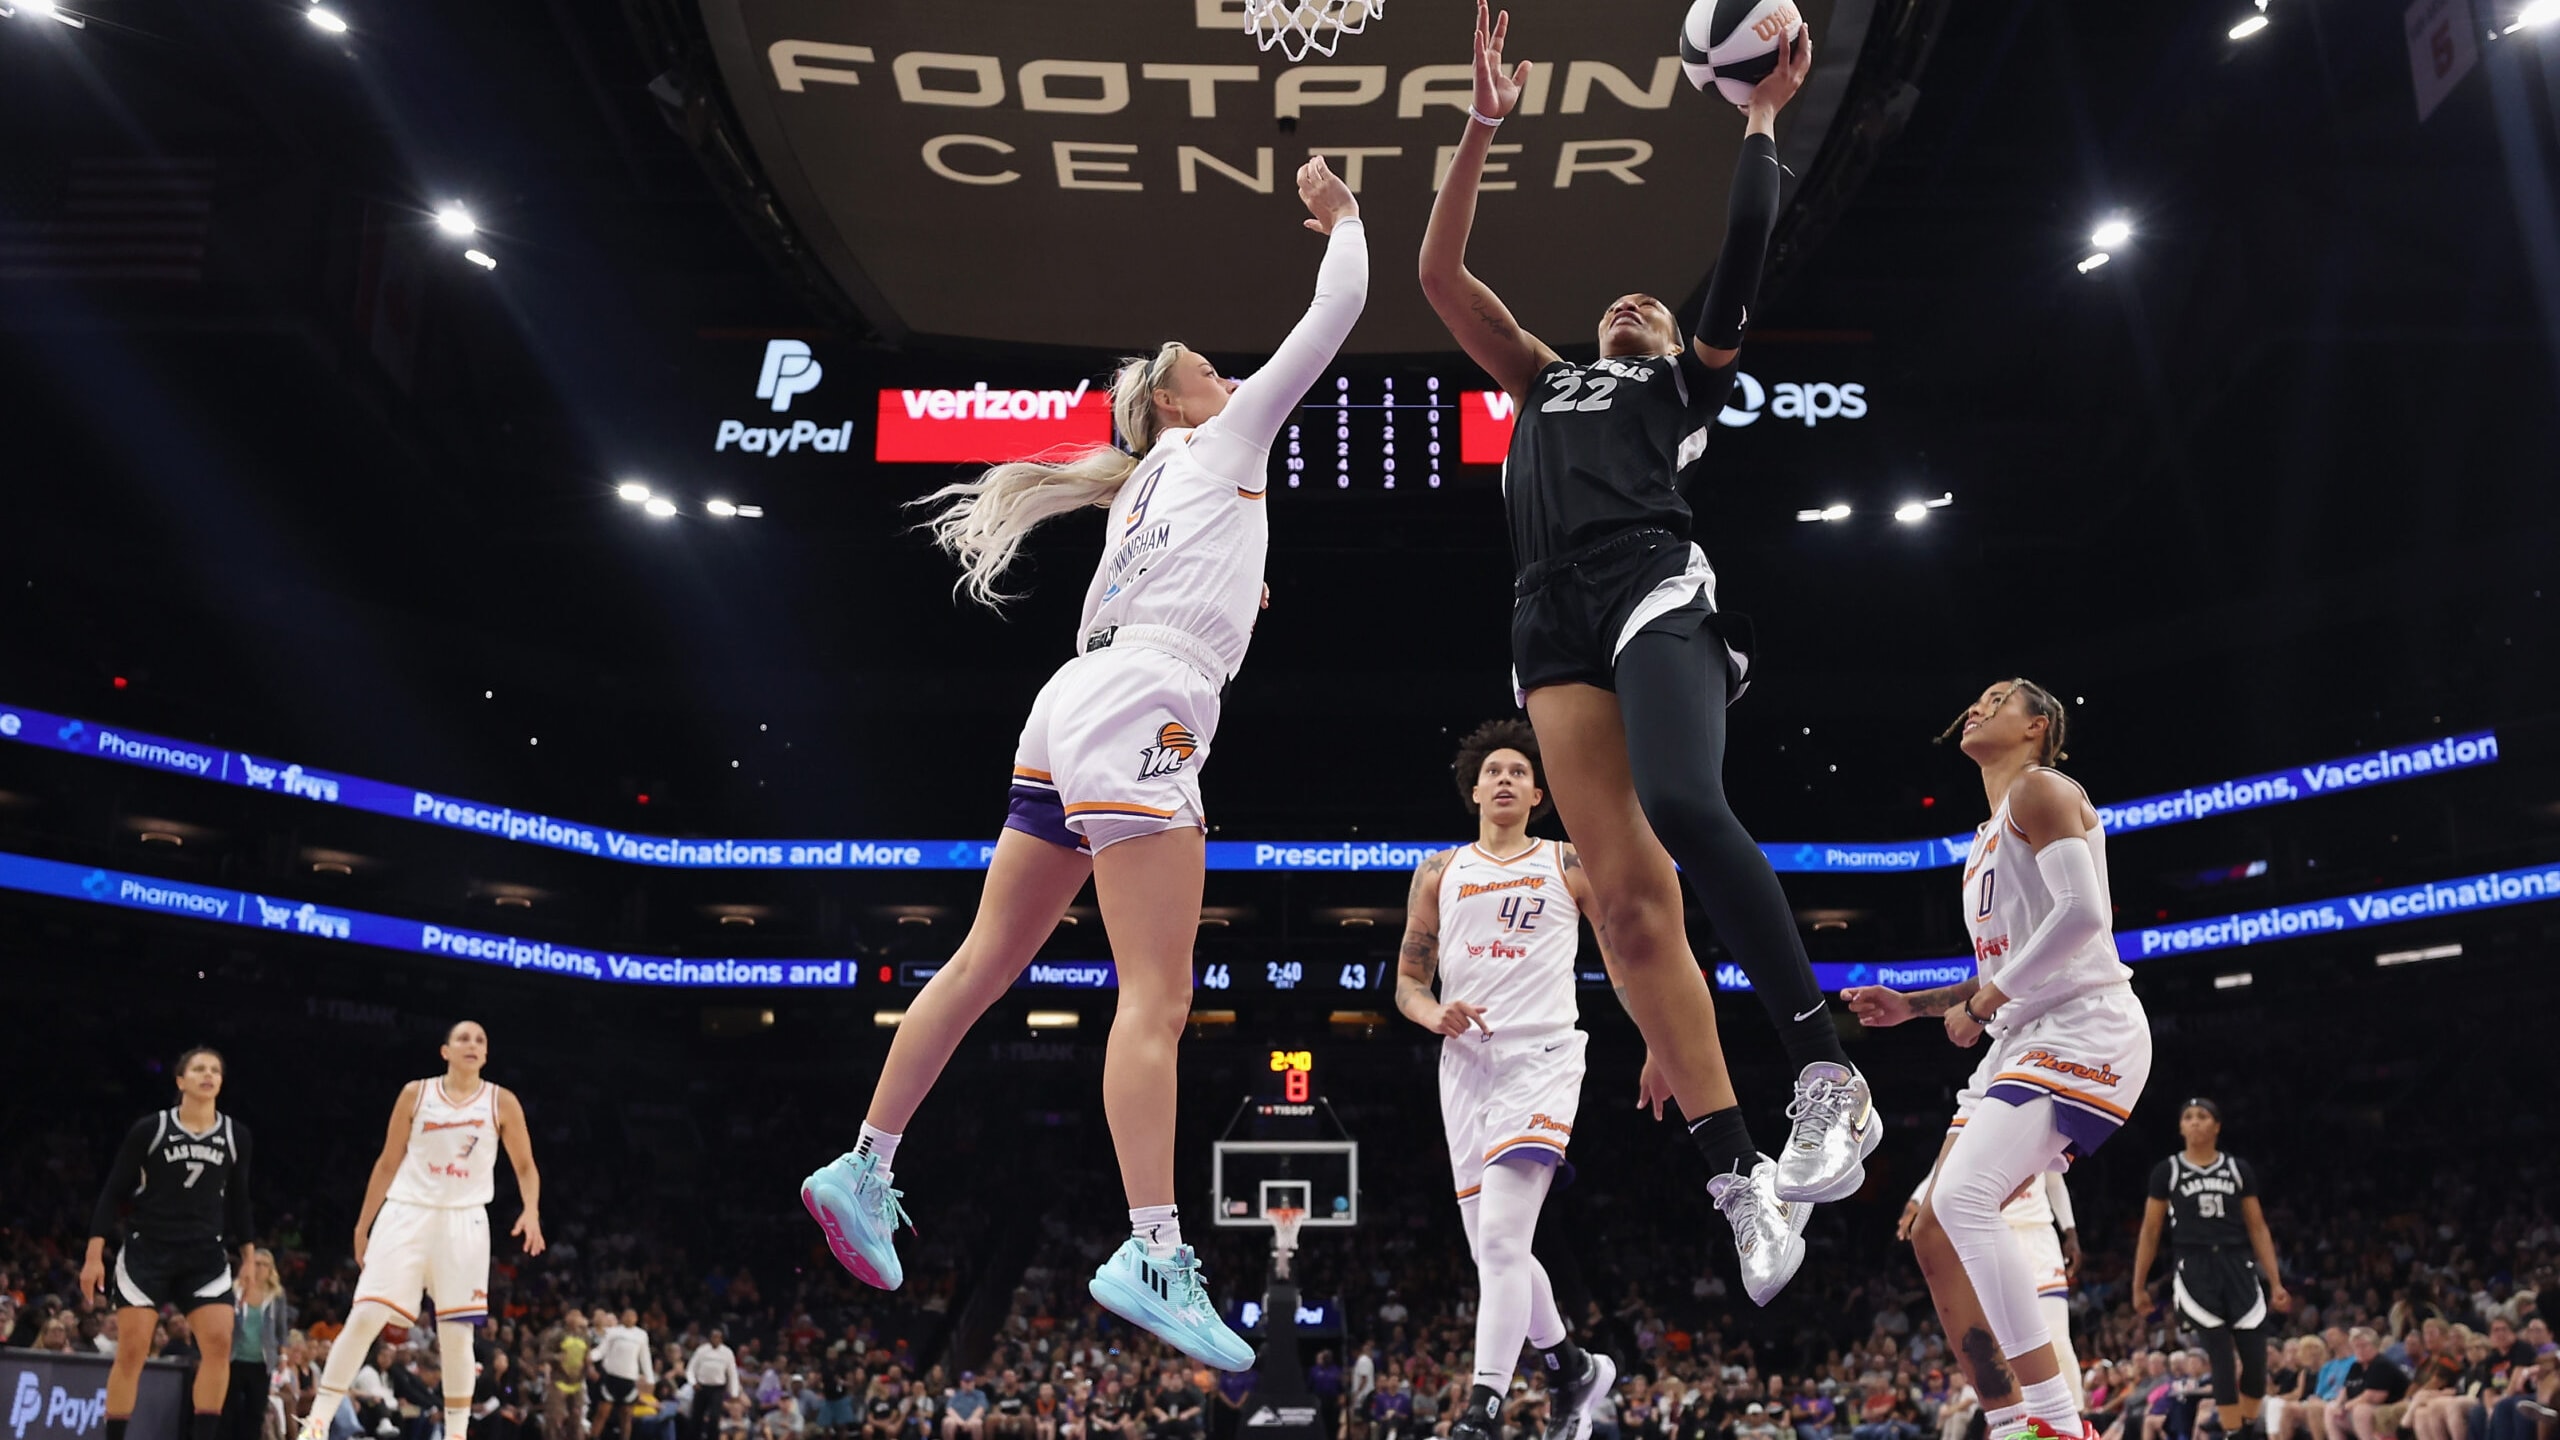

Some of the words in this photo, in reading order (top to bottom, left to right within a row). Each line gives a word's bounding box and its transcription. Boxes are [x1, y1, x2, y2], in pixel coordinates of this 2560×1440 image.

[768, 39, 1683, 118] FOOTPRIN
[922, 134, 1653, 194] CENTER
[1337, 377, 1348, 391] 0
[1427, 377, 1439, 391] 0
[1541, 376, 1618, 412] 22
[902, 381, 1070, 419] verizon
[1383, 393, 1394, 406] 2
[1771, 381, 1868, 428] aps
[1338, 410, 1348, 424] 2
[1428, 410, 1439, 424] 0
[715, 420, 853, 457] PayPal
[1289, 425, 1299, 440] 2
[1337, 425, 1349, 440] 0
[1383, 425, 1394, 440] 2
[1289, 441, 1300, 456] 5
[1338, 441, 1348, 456] 2
[1428, 441, 1440, 456] 0
[1286, 457, 1304, 472] 10
[1384, 457, 1395, 472] 0
[1288, 473, 1299, 488] 8
[1337, 473, 1349, 488] 0
[1384, 473, 1394, 488] 2
[1429, 473, 1440, 488] 0
[1121, 462, 1166, 546] 9
[99, 731, 212, 776] Pharmacy
[2098, 777, 2298, 829] Prescriptions,
[2302, 735, 2498, 792] Vaccination
[413, 792, 599, 855] Prescriptions,
[606, 831, 783, 864] Vaccinations
[789, 842, 843, 864] and
[850, 843, 921, 864] More
[1256, 842, 1438, 870] Prescription
[1825, 849, 1920, 868] Pharmacy
[121, 880, 228, 918] Pharmacy
[1976, 868, 1995, 923] 0
[1498, 896, 1546, 934] 42
[2142, 905, 2344, 954] Prescriptions,
[2348, 871, 2560, 921] Vaccinations
[422, 925, 602, 979] Prescriptions,
[607, 956, 782, 983] Vaccinations
[789, 961, 842, 983] and
[1030, 965, 1108, 986] Mercury
[1203, 964, 1231, 989] 46
[1267, 962, 1302, 981] 2:40
[1339, 964, 1366, 989] 43
[1877, 965, 1970, 987] Pharmacy
[1270, 1051, 1312, 1071] 2:40
[2017, 1050, 2122, 1087] Phoenix
[1285, 1069, 1309, 1102] 8
[164, 1144, 189, 1163] LAS
[183, 1161, 204, 1188] 7
[2198, 1193, 2225, 1218] 51
[46, 1386, 107, 1429] PayP
